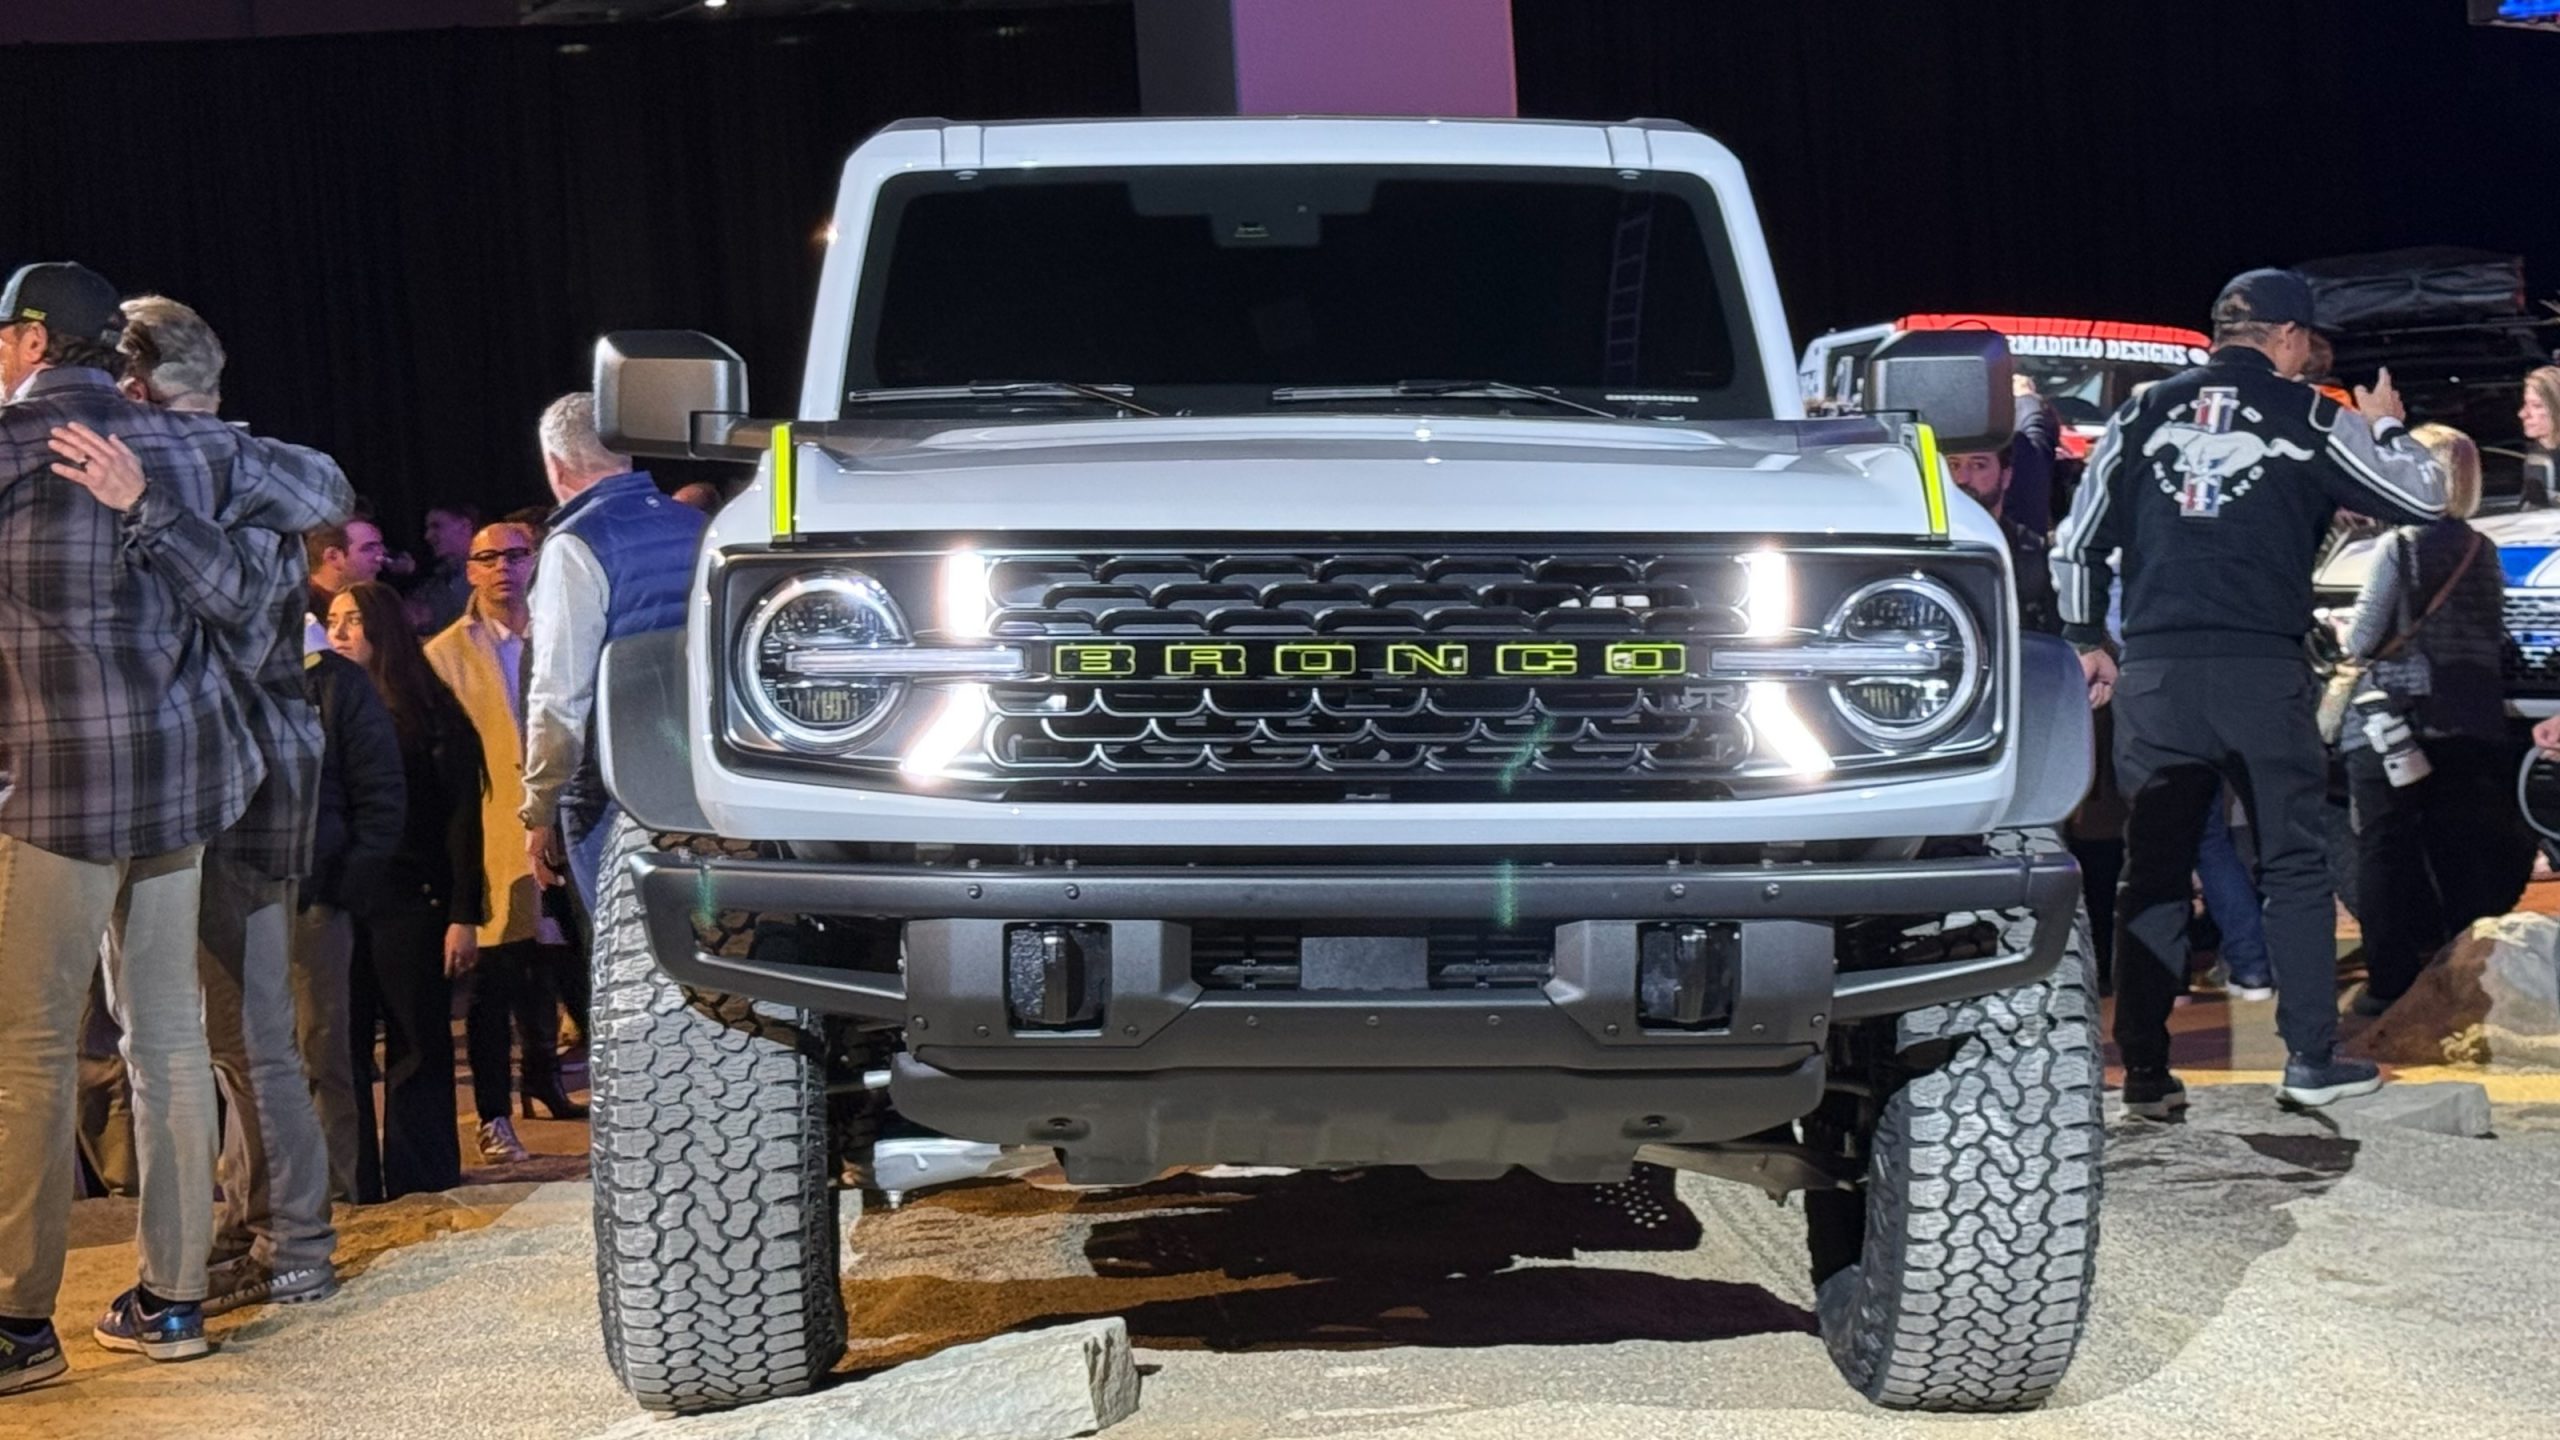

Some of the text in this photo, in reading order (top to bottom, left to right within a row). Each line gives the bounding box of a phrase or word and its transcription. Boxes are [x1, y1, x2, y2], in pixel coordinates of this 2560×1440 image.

[2005, 334, 2188, 365] RMADILLO DESIGNS
[1054, 644, 1687, 675] BRONCO
